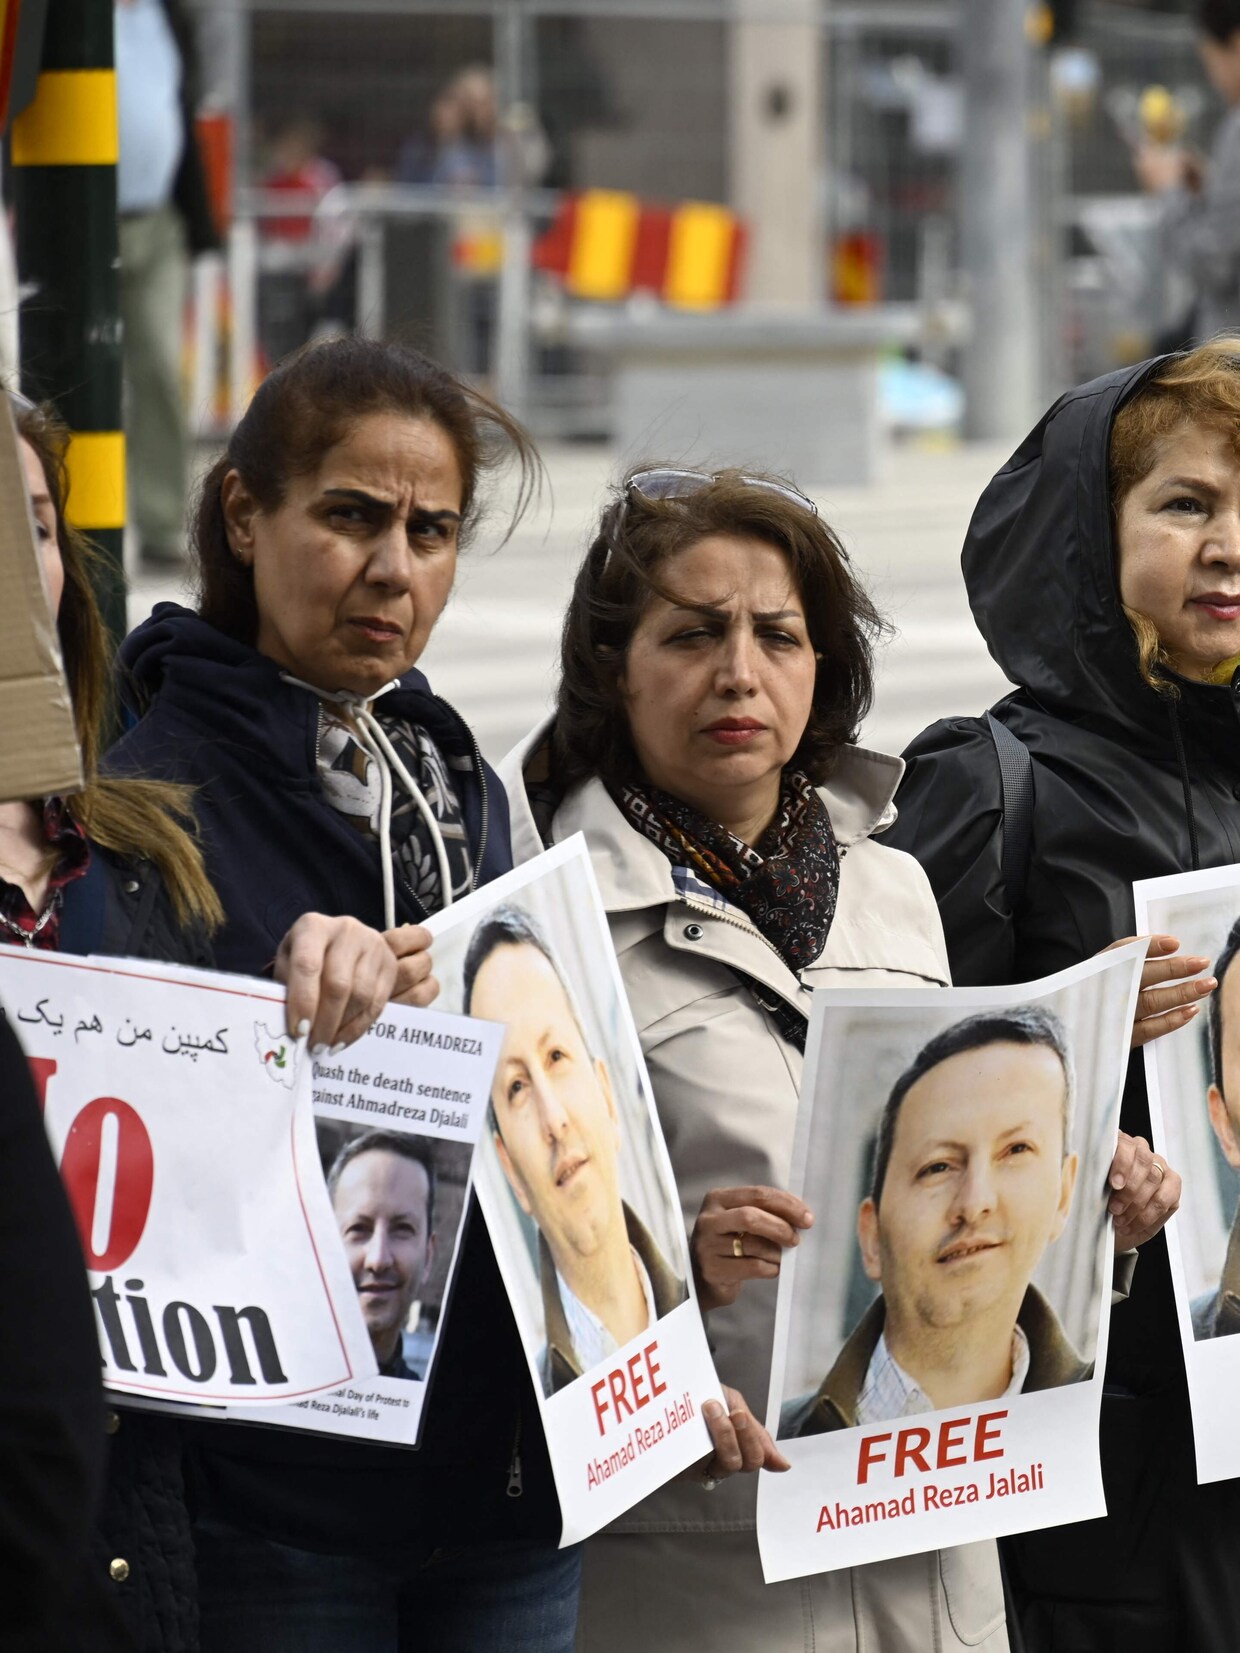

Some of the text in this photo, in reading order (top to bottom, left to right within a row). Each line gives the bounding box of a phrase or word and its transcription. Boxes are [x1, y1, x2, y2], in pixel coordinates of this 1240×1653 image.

[17, 998, 64, 1036] یک
[74, 1014, 103, 1044] هم
[116, 1018, 153, 1047] من
[162, 1026, 229, 1063] کمپین
[399, 1027, 483, 1056] AHMADREZA
[349, 1069, 370, 1086] the
[373, 1073, 413, 1094] death
[416, 1084, 472, 1104] sentence
[346, 1094, 426, 1121] Ahmadreza
[429, 1108, 470, 1129] Djalali
[27, 1056, 154, 1272] O
[92, 1275, 289, 1385] tion
[310, 1400, 331, 1413] Reza
[347, 1389, 364, 1401] Day
[365, 1393, 375, 1402] of
[375, 1394, 402, 1406] Protest
[590, 1340, 668, 1437] FREE
[586, 1391, 695, 1492] Ahamad Reza Jalali
[856, 1409, 1009, 1486] FREE
[816, 1462, 1044, 1533] Ahamad Reza Jalali
